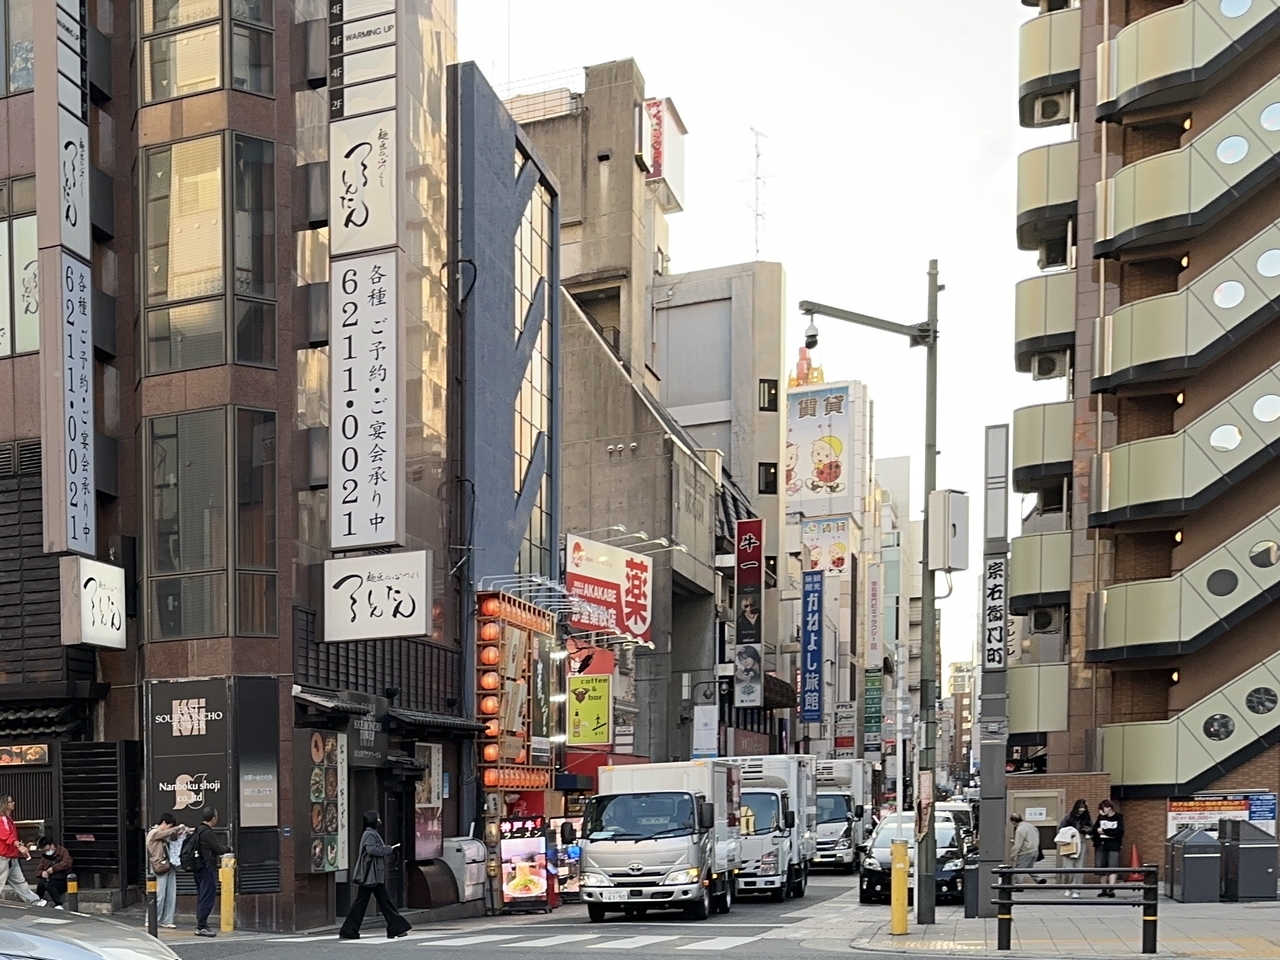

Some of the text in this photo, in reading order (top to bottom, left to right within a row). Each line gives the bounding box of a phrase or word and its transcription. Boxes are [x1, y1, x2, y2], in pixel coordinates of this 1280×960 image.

[331, 4, 342, 14] 4F
[331, 24, 395, 46] 4F WARMING UP
[331, 67, 342, 78] 4F
[331, 99, 343, 110] 2F
[797, 394, 845, 419] 賃貸
[739, 533, 760, 569] 牛一
[584, 583, 617, 603] AKAKABE
[625, 557, 648, 626] 薬
[986, 561, 1004, 665] 宗右衛門町
[806, 592, 821, 711] かねよし旅館
[581, 677, 608, 685] coffee
[588, 693, 603, 701] bar
[177, 704, 200, 714] EAST
[155, 711, 223, 724] SOUEMONCHO
[172, 720, 206, 730] TOWER
[159, 780, 221, 793] Nanboku shoji
[504, 830, 542, 839] ラーメン
